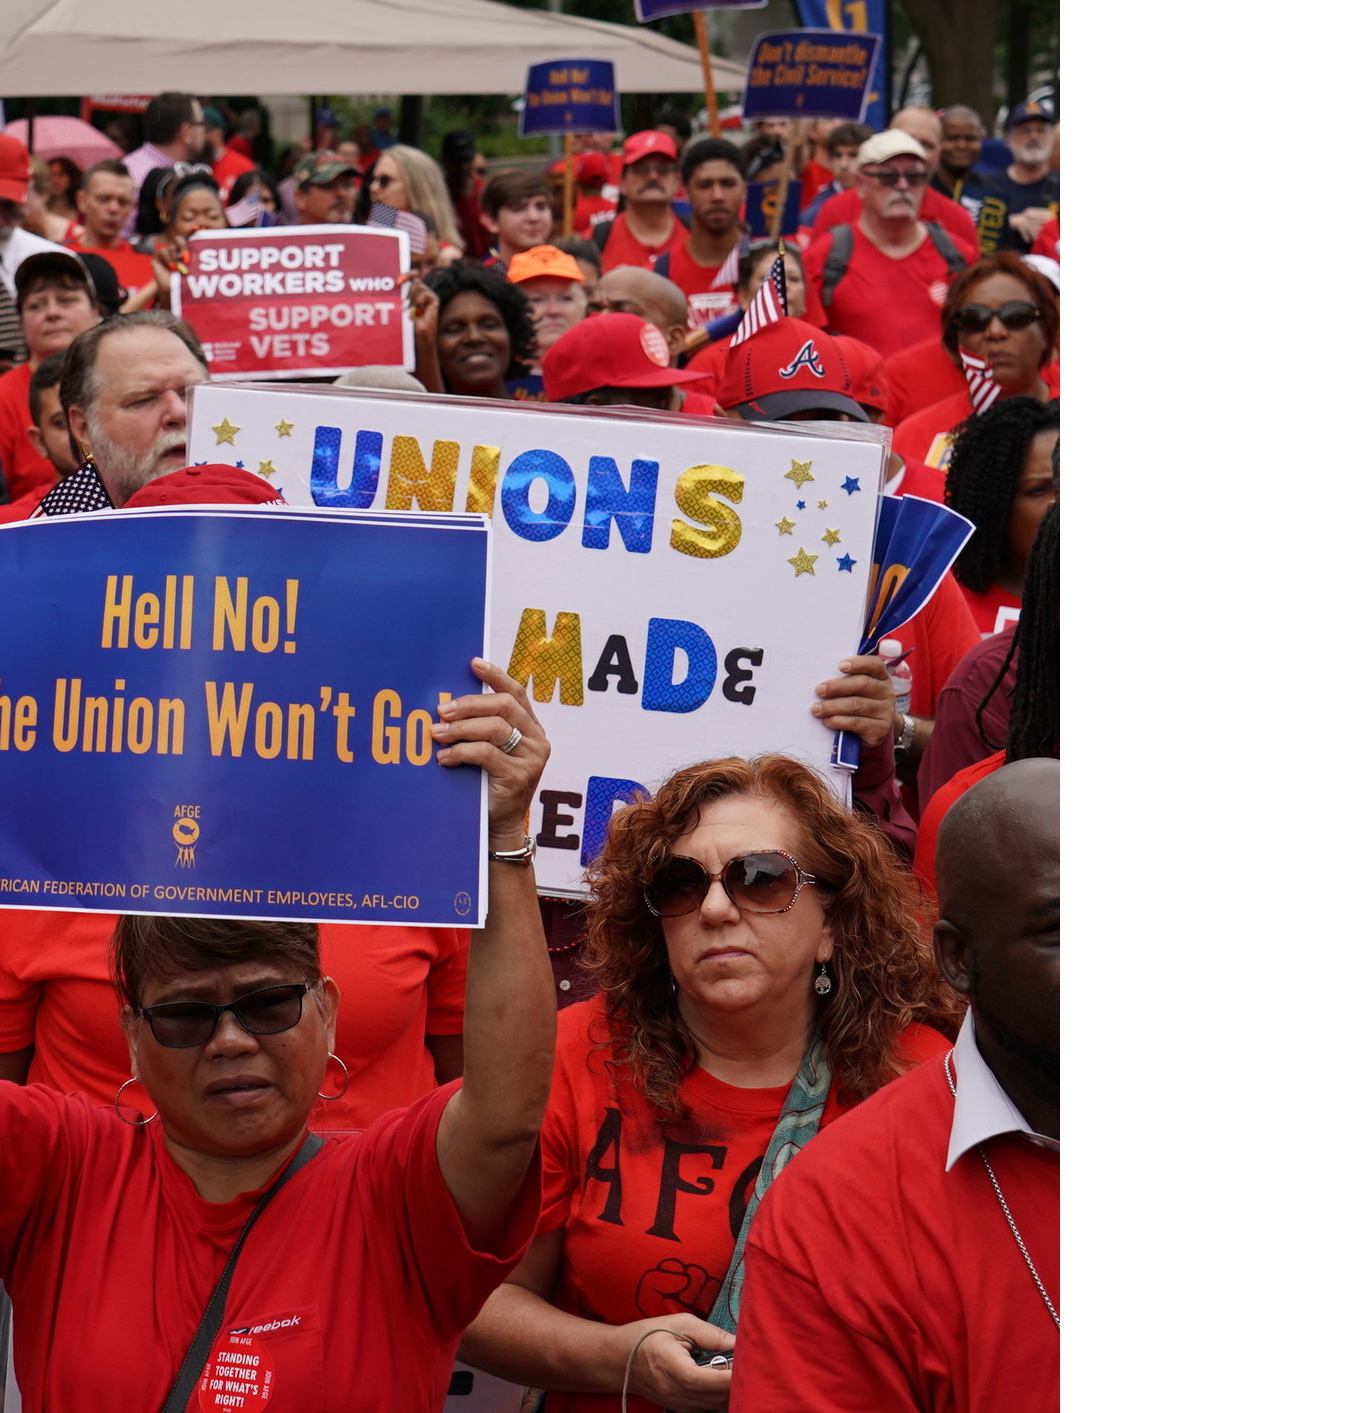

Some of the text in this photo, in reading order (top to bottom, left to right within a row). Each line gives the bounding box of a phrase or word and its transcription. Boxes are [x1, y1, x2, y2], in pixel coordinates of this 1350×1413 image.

[198, 243, 345, 272] SUPPORT
[186, 270, 395, 299] WORKERS WHO
[248, 302, 396, 332] SUPPORT
[249, 332, 330, 359] VETS
[310, 425, 746, 560] UNIONS
[100, 574, 299, 654] Hell No!
[507, 607, 764, 714] MADE
[52, 677, 184, 756] Union
[204, 681, 356, 764] Won't
[173, 805, 201, 818] AFGE
[43, 881, 126, 897] FEDERATION
[130, 884, 150, 898] OF
[154, 886, 264, 904] GOVERNMENT
[267, 890, 358, 909] EMPLOYEES,
[361, 894, 420, 909] AFL-CIO
[215, 1365, 257, 1381] TOGETHER
[217, 1352, 260, 1366] STANDING
[209, 1379, 259, 1395] FOR WHAT'S
[214, 1394, 245, 1408] RIGHT!
